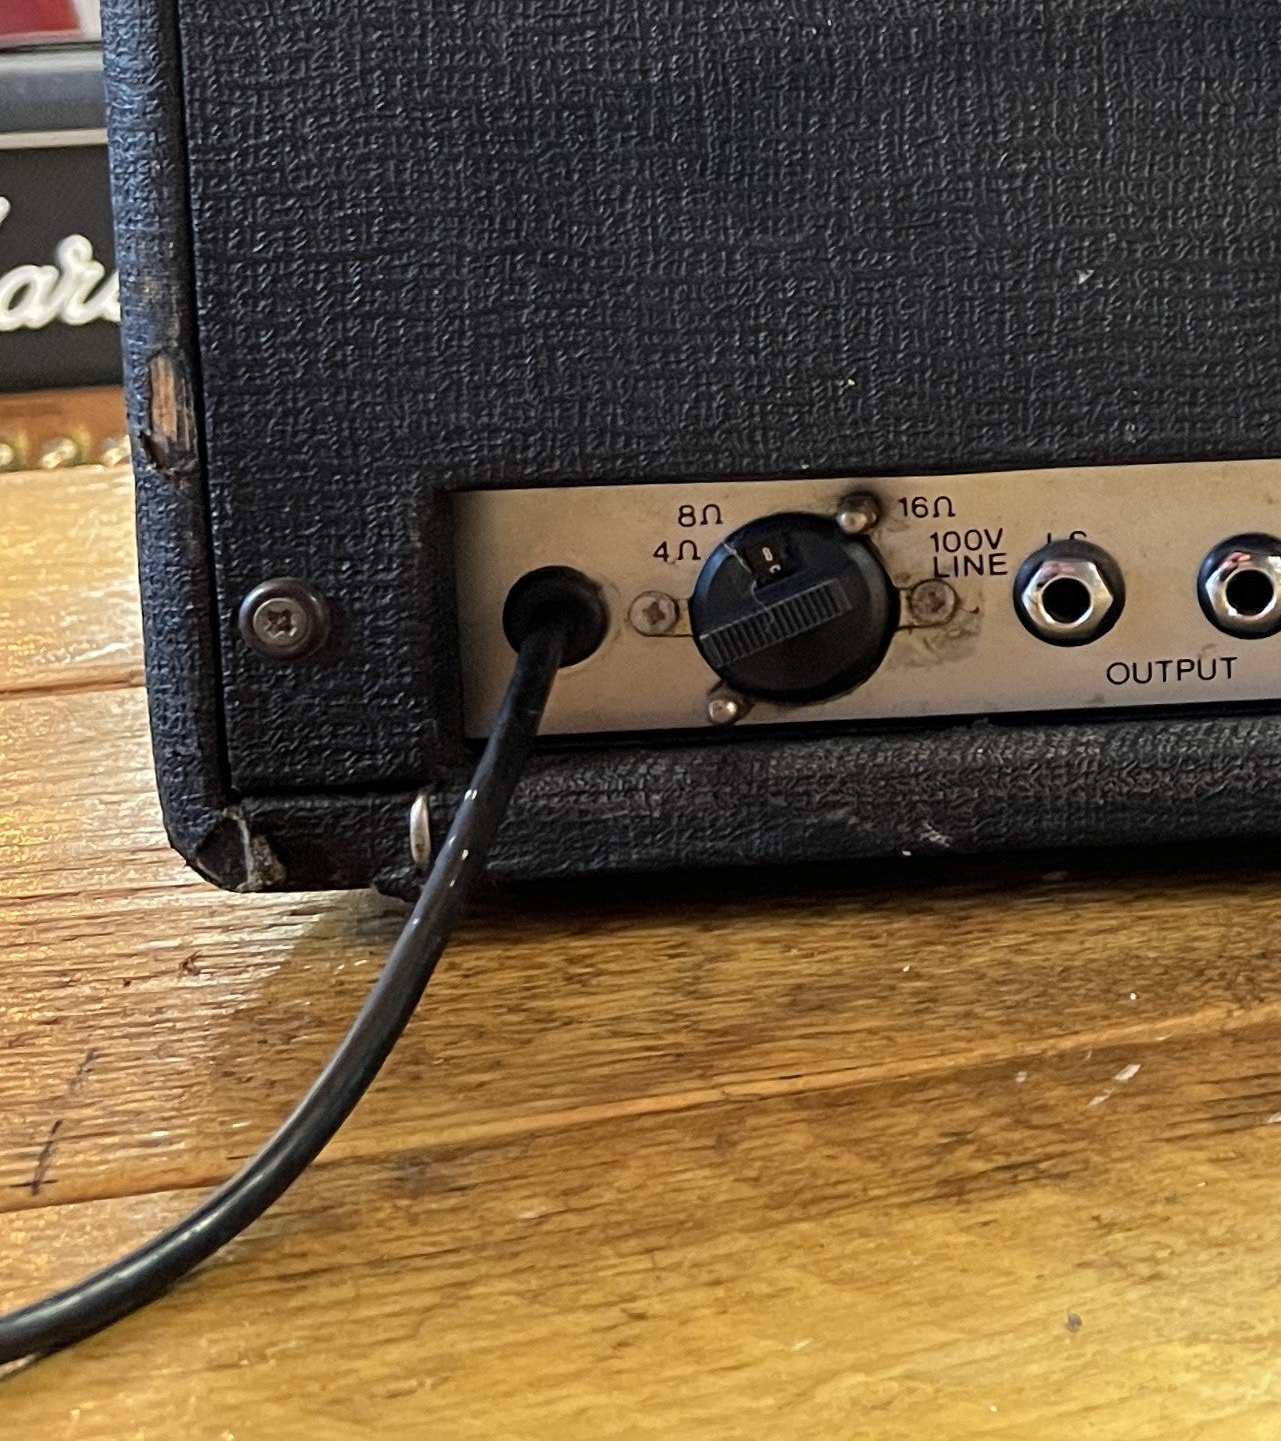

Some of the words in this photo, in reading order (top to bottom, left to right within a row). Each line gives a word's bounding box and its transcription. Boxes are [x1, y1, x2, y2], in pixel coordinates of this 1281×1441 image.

[678, 503, 723, 527] 8Ω
[899, 495, 956, 519] 16Ω
[929, 527, 1003, 553] 100V
[933, 552, 1008, 578] LINE
[1106, 657, 1238, 686] OUTPUT
